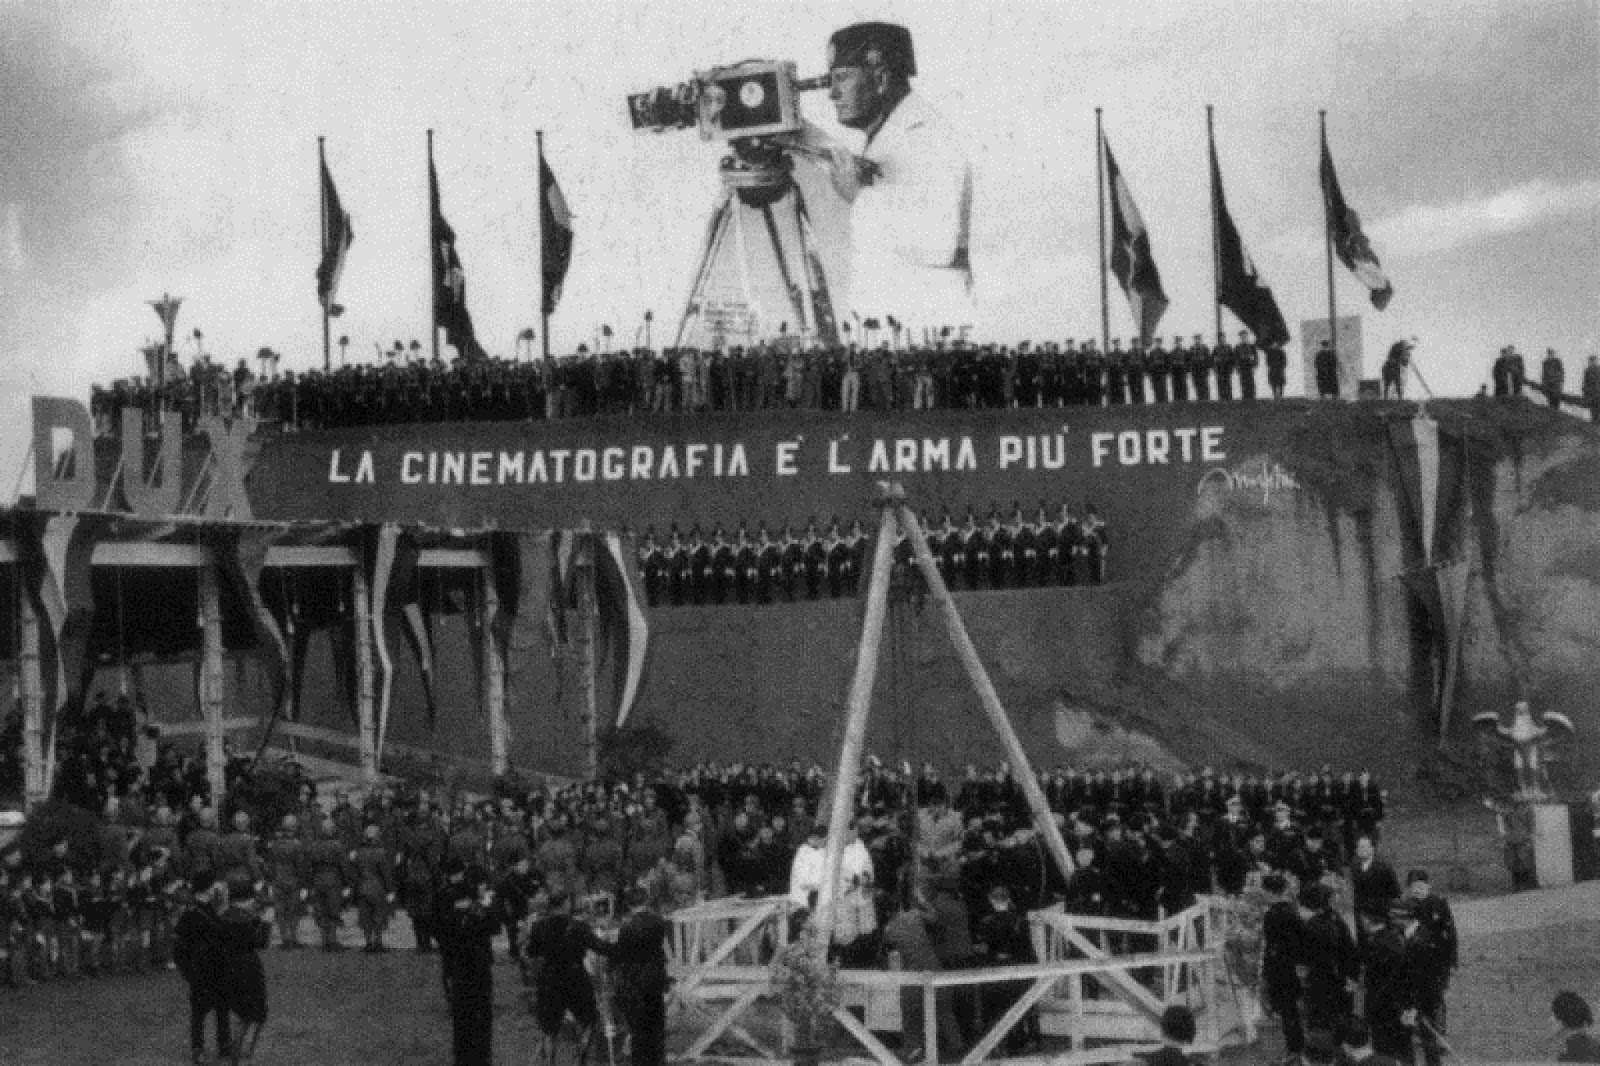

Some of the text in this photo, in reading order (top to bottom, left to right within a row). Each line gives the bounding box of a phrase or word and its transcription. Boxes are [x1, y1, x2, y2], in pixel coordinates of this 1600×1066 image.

[32, 396, 258, 523] DUX
[329, 449, 376, 484] LA
[400, 442, 749, 486] CINEMATOGRAFIA
[1091, 425, 1227, 467] FORTE
